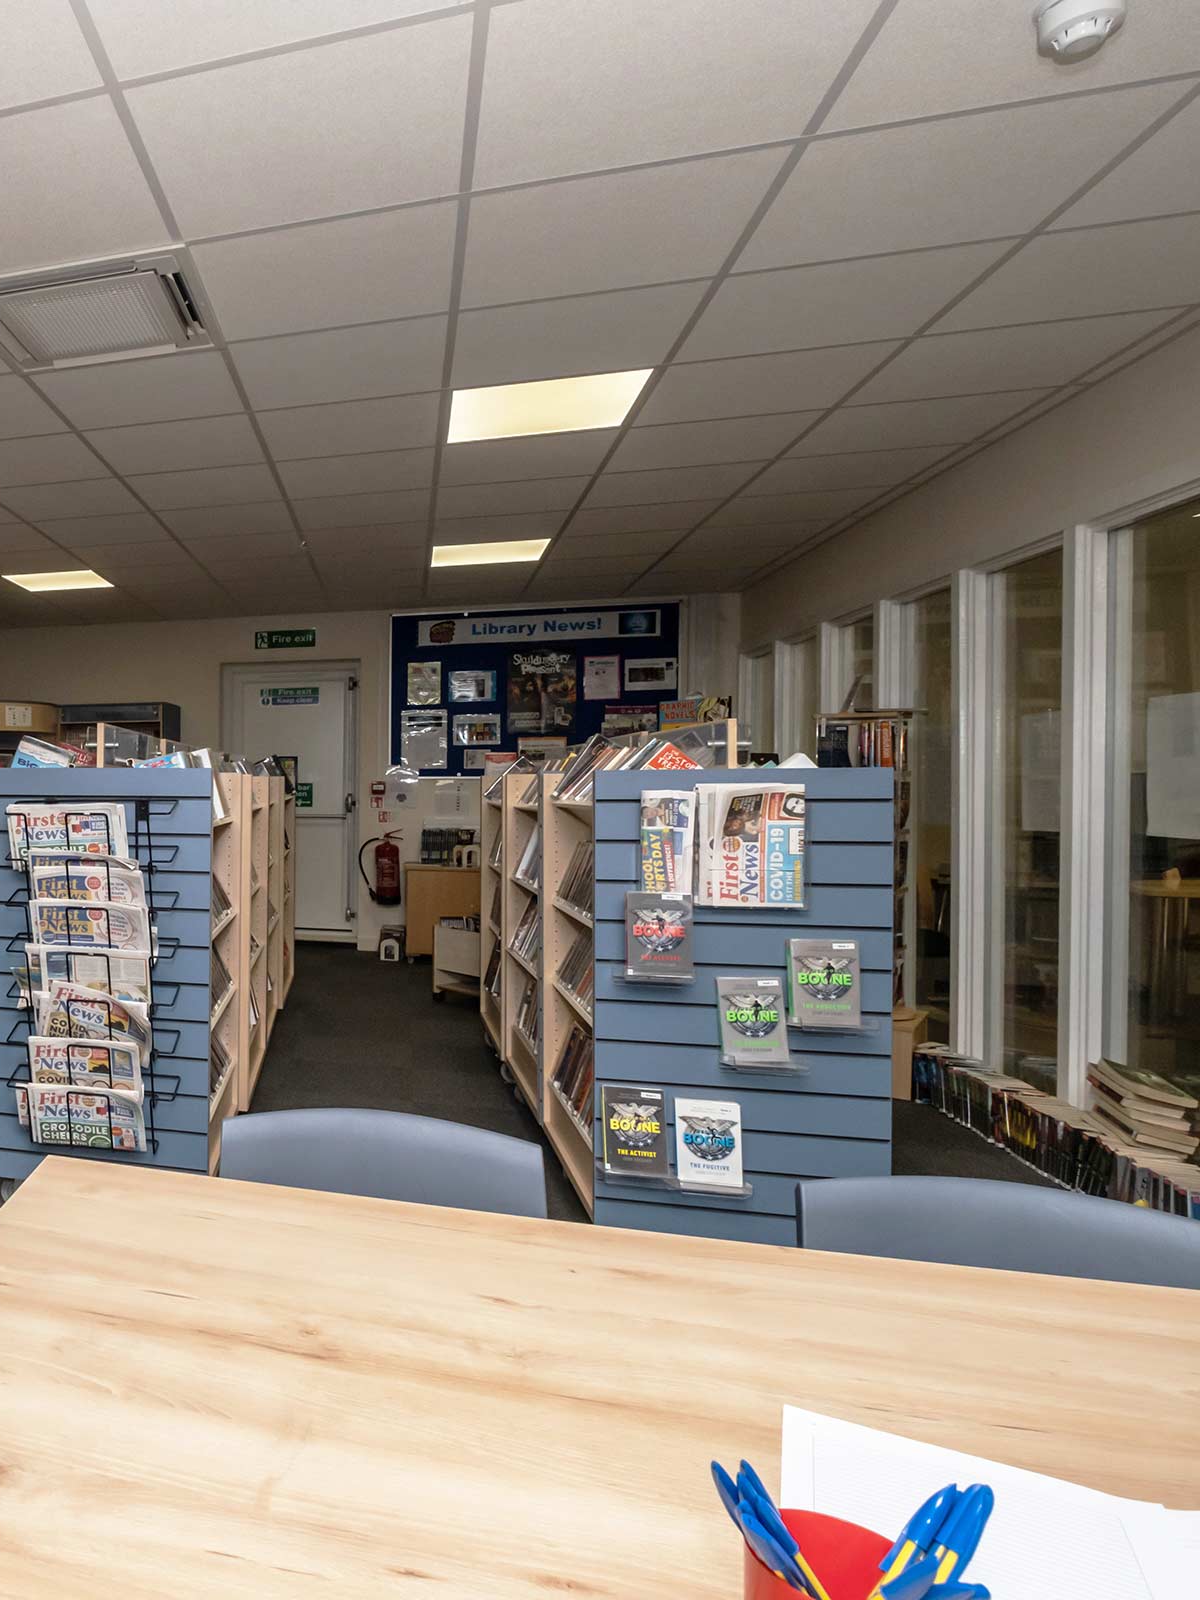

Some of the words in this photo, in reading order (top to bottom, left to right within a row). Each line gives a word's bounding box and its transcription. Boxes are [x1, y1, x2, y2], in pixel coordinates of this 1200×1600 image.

[471, 623, 537, 637] Library
[544, 618, 603, 633] News!
[272, 635, 291, 643] Fire
[294, 633, 313, 642] exit
[296, 687, 313, 695] exit
[665, 710, 696, 720] NOVELS
[16, 812, 56, 828] First
[22, 827, 67, 841] News
[740, 843, 759, 898] News
[769, 827, 784, 901] COVID-19
[41, 878, 78, 890] First
[719, 854, 739, 901] First
[48, 890, 88, 900] News
[43, 907, 79, 920] First
[48, 919, 89, 933] News
[633, 924, 686, 938] BOONE
[798, 972, 853, 986] BOONE
[55, 987, 98, 1009] First
[57, 1000, 104, 1025] News
[726, 1010, 779, 1022] BOONE
[35, 1045, 77, 1058] First
[40, 1057, 87, 1072] News
[40, 1092, 80, 1105] First
[44, 1105, 91, 1120] News
[610, 1118, 661, 1134] BOONE
[684, 1132, 736, 1148] BOONE
[630, 1150, 657, 1158] ACTIVIST
